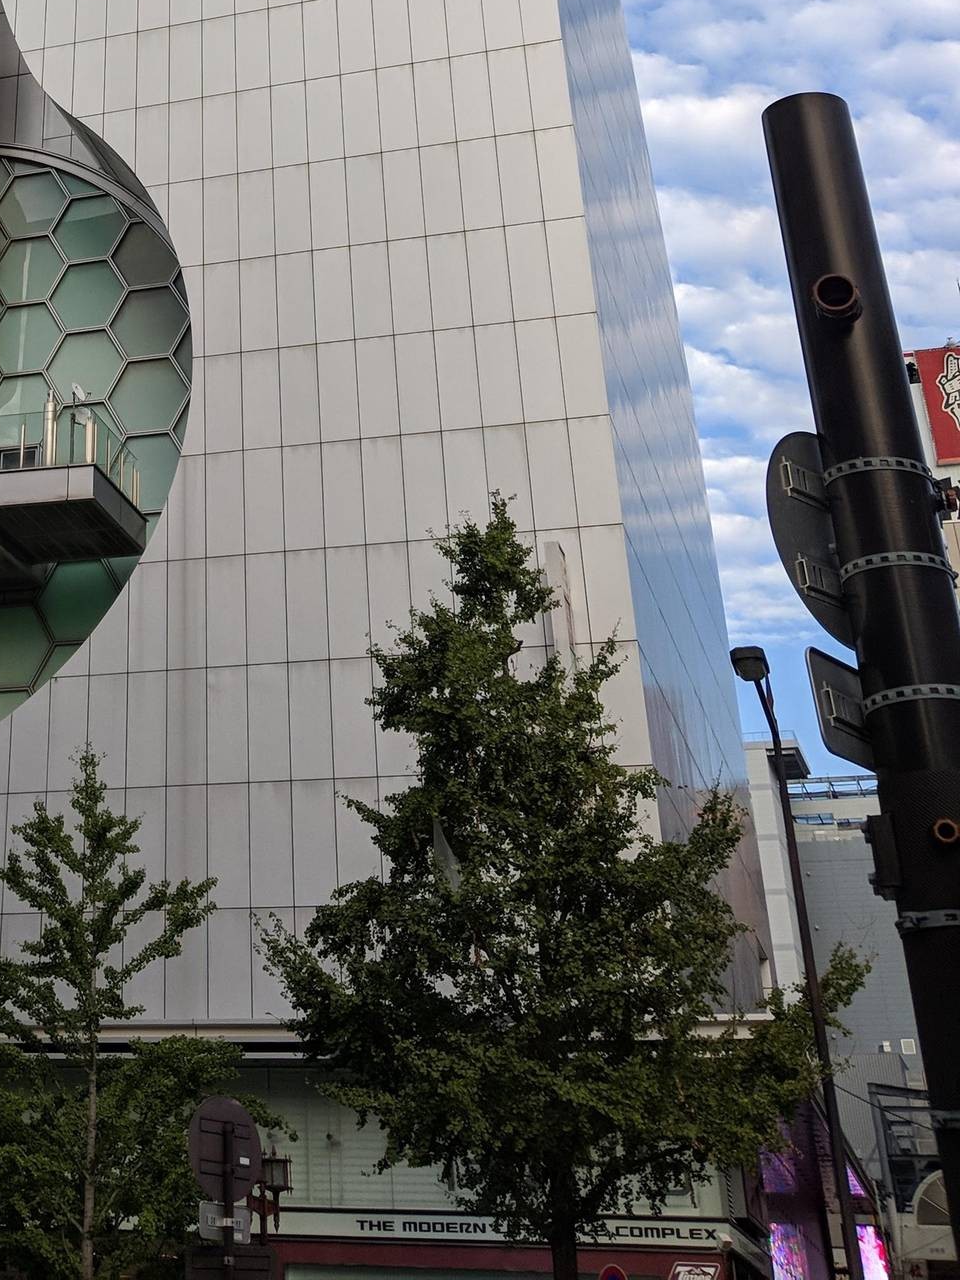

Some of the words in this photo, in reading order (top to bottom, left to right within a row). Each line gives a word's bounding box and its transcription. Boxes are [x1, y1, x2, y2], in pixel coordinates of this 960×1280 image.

[356, 1220, 395, 1232] THE
[402, 1221, 486, 1233] MODERN
[616, 1226, 716, 1240] COMPLEX
